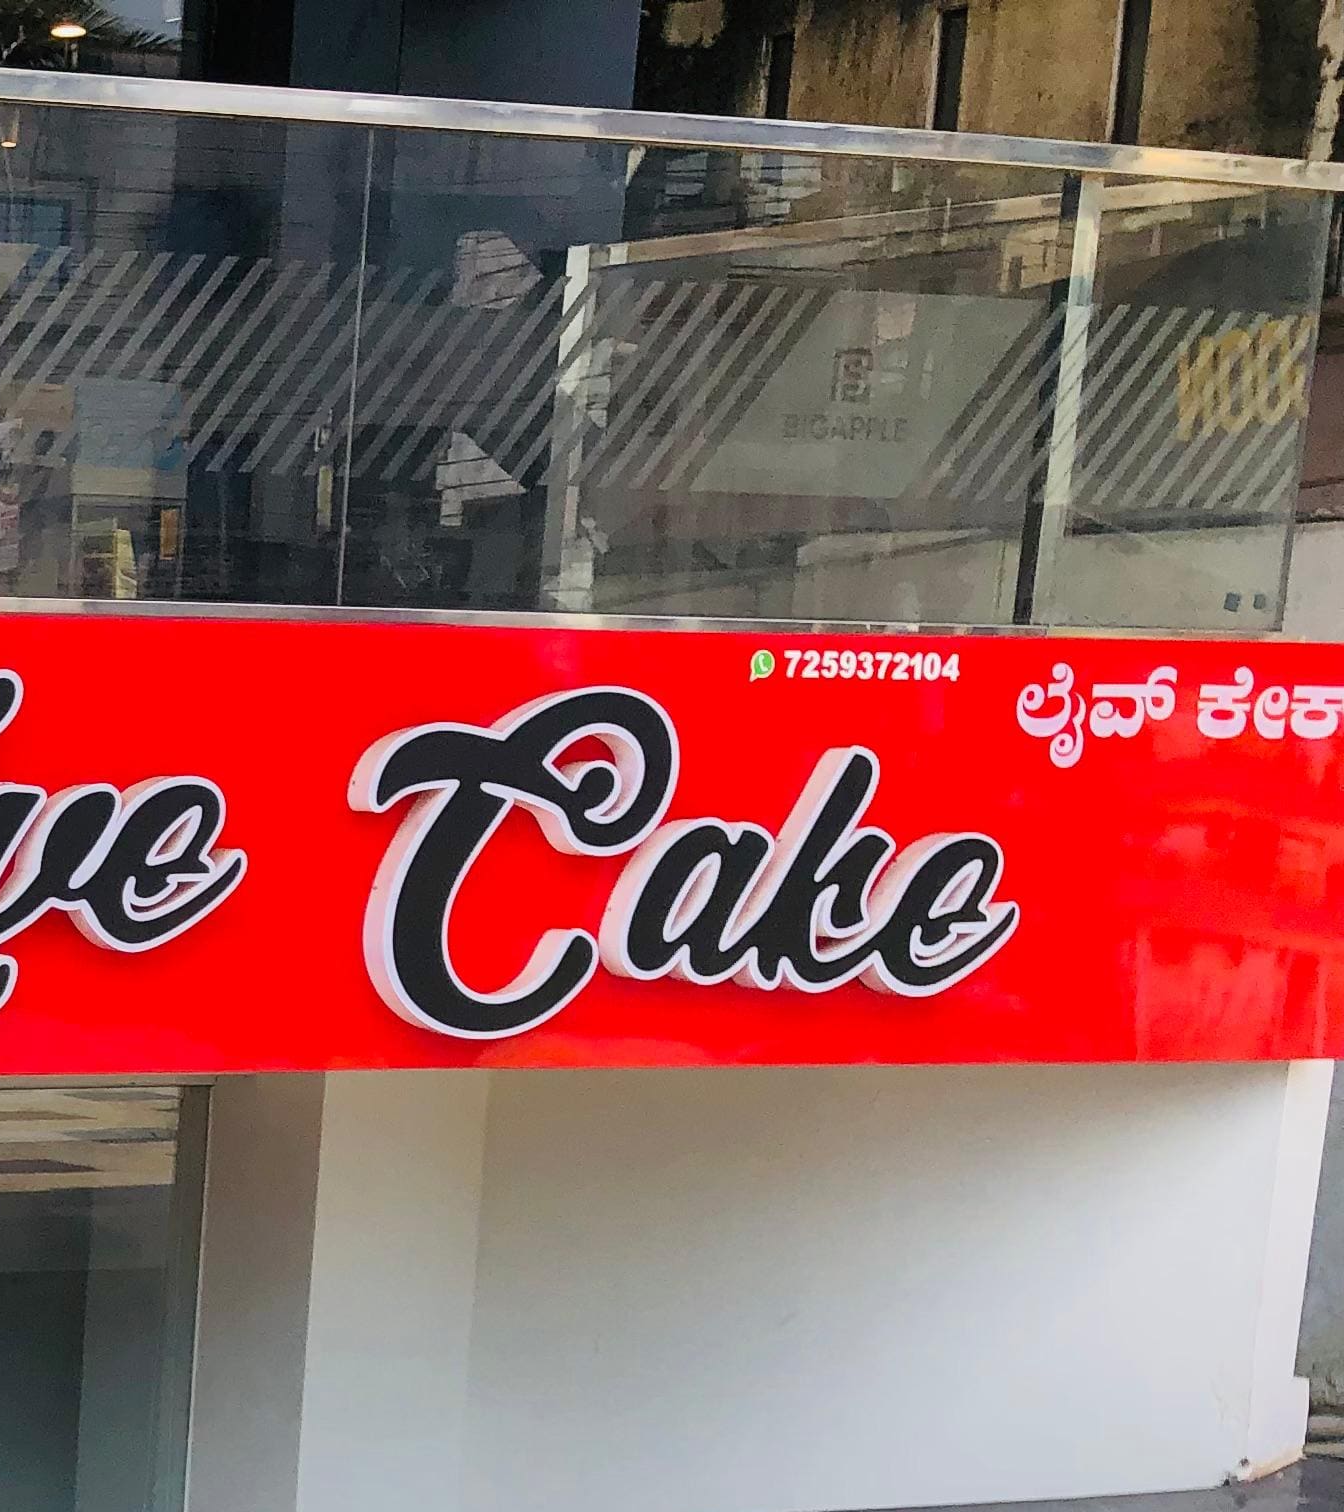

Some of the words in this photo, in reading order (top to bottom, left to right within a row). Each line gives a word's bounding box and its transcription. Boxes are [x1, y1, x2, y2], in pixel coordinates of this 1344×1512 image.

[783, 649, 960, 682] 7259372104
[1015, 661, 1178, 769] ಲೈವ್
[347, 685, 1020, 1041] Cake
